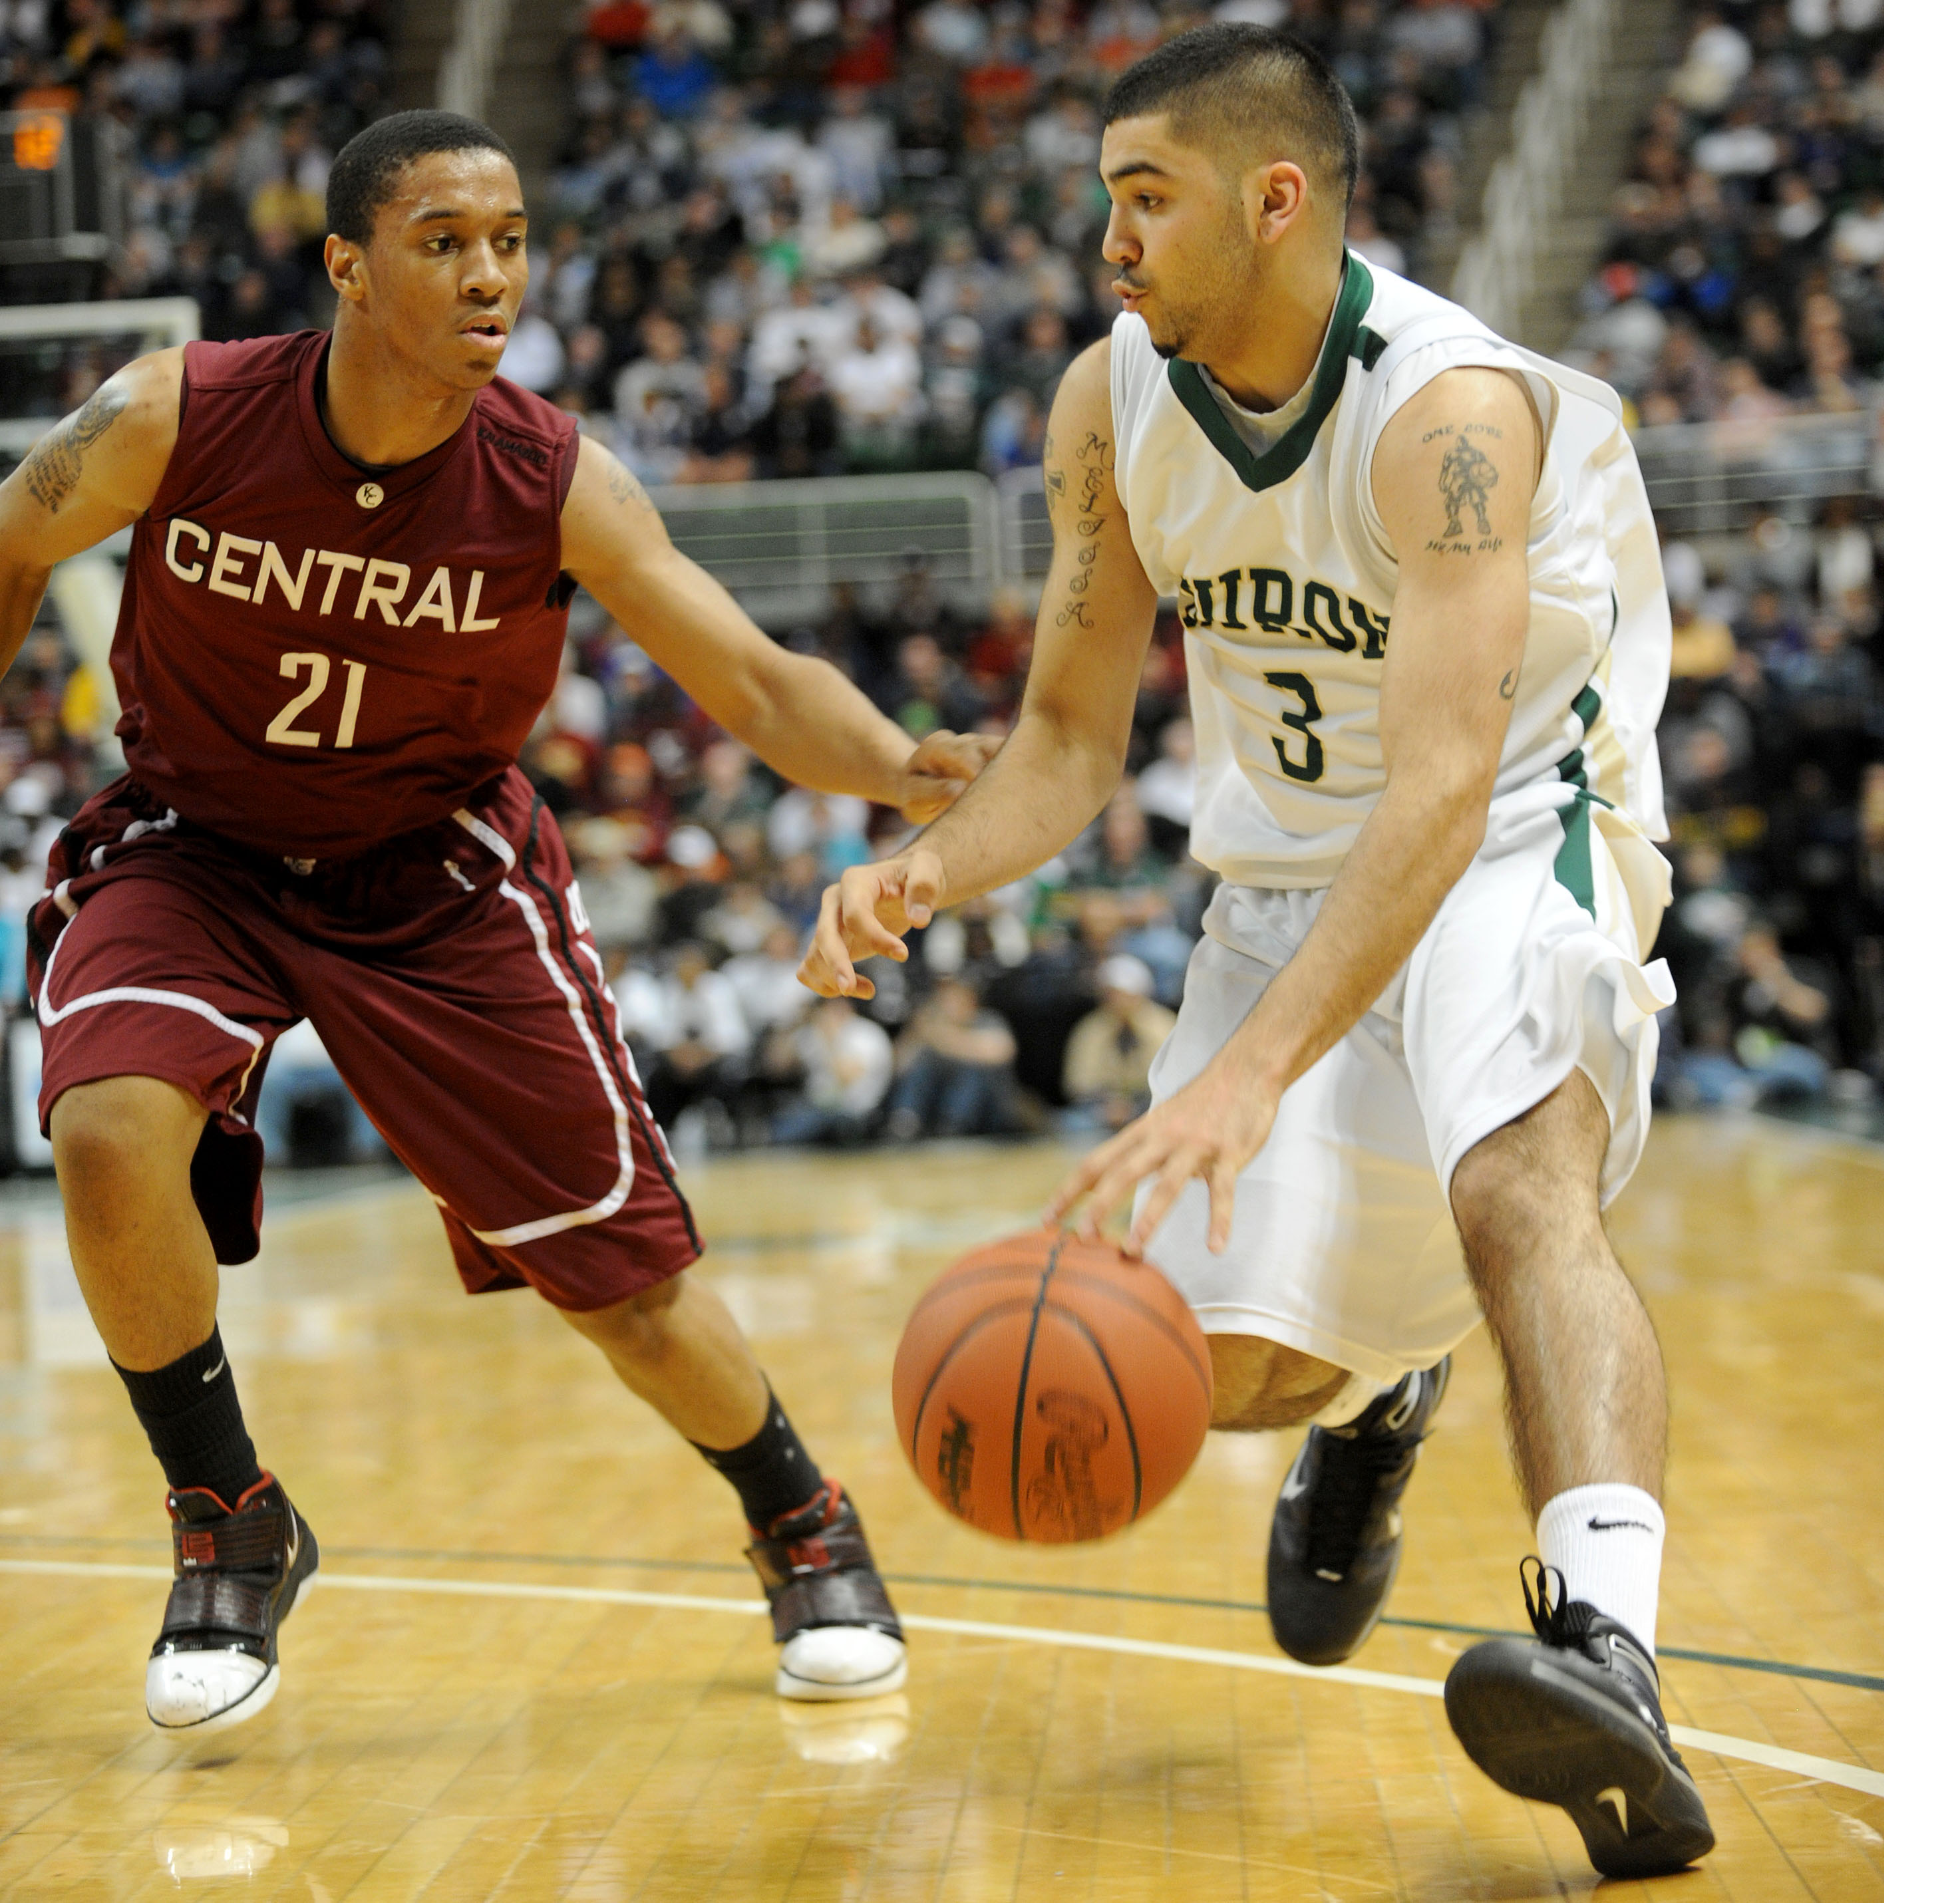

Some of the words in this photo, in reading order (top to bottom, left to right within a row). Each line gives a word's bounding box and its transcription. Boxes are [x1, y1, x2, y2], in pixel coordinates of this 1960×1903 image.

[165, 517, 501, 633] CENTRAL
[265, 652, 367, 748] 21
[1263, 672, 1323, 782] 3
